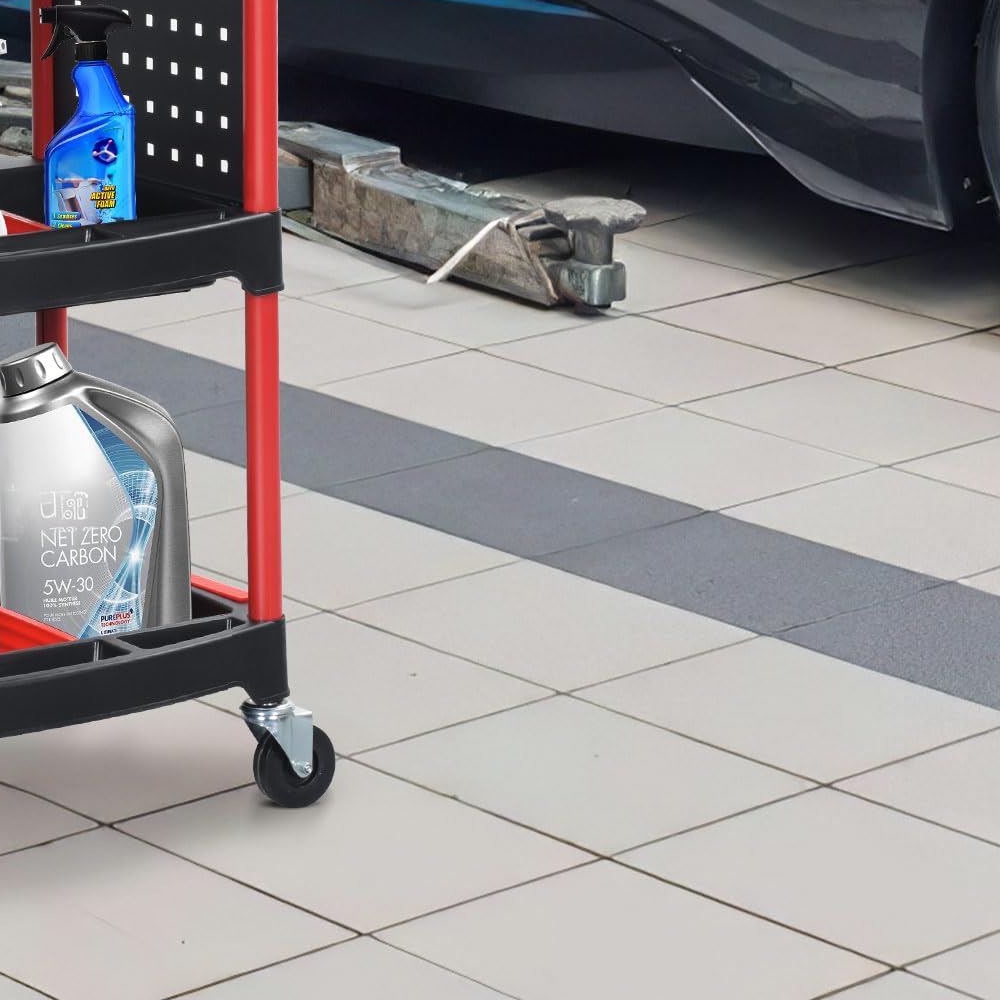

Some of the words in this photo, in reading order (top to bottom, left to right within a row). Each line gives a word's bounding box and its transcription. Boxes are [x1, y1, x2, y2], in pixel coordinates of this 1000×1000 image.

[90, 191, 115, 200] ACTIVE
[96, 200, 115, 209] FOAM
[41, 527, 77, 548] NET
[81, 525, 122, 545] ZERO
[41, 545, 117, 568] CARBON
[43, 576, 94, 595] 5W-30
[100, 612, 131, 622] PUREPLUS
